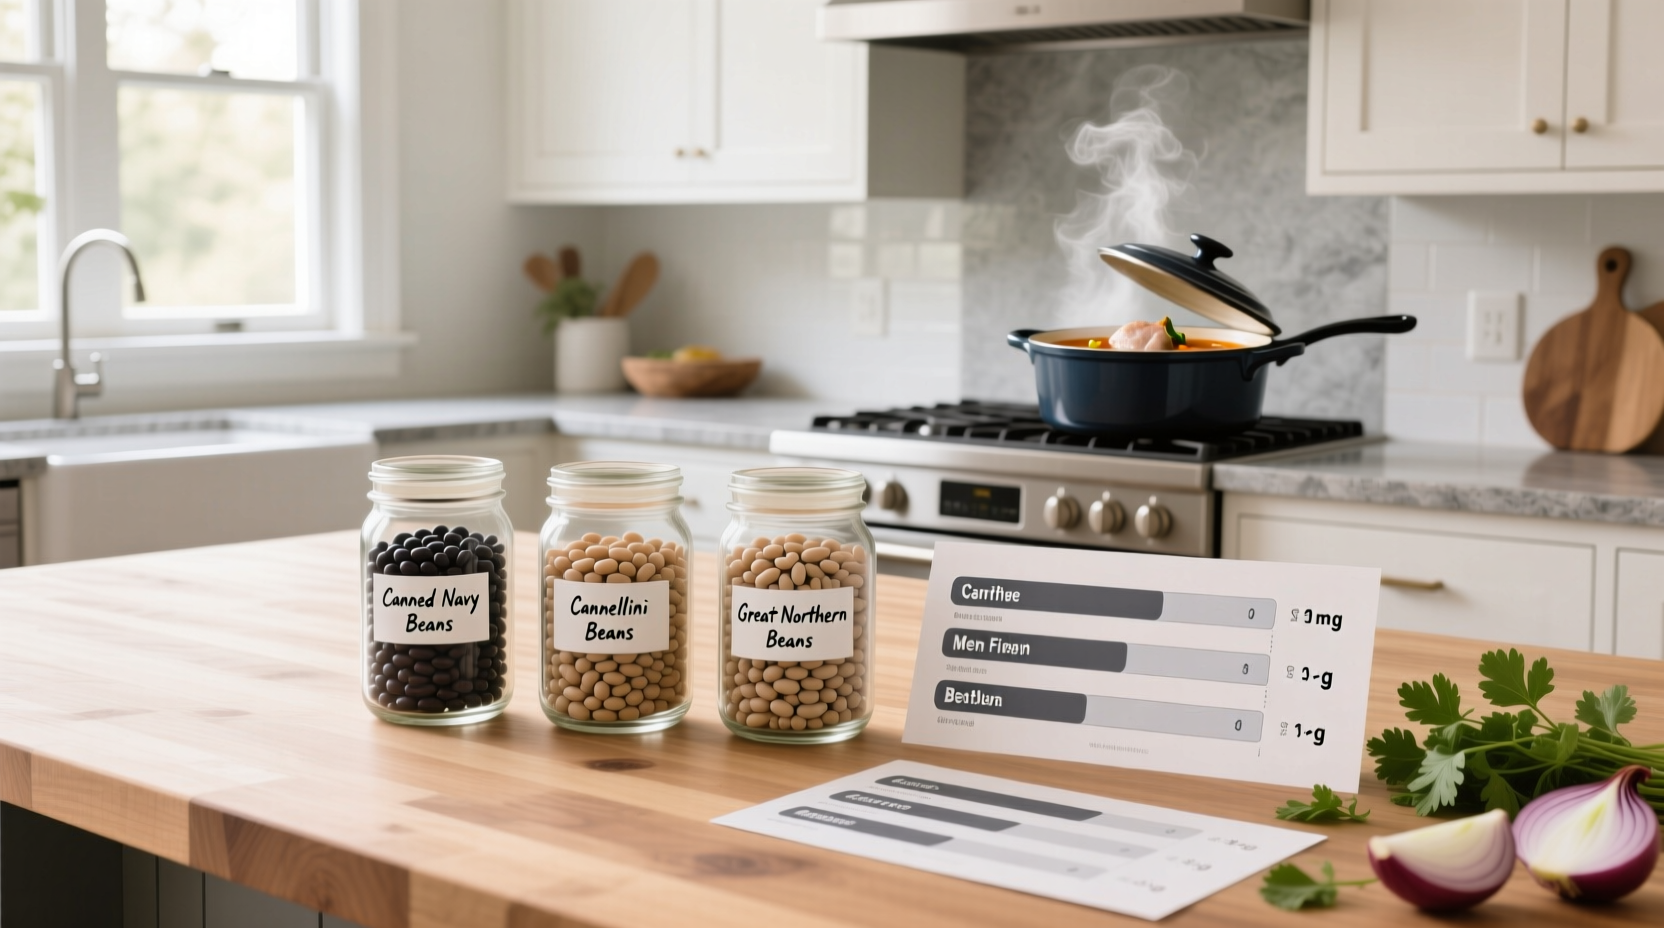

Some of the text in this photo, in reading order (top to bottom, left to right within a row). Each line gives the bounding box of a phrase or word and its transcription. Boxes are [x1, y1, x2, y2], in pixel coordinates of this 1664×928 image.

[382, 587, 480, 615] Canned Navy
[570, 595, 649, 617] Cannellini
[405, 612, 454, 633] Beans
[737, 602, 847, 624] Great Northern
[584, 621, 634, 642] Beans
[765, 629, 813, 649] Beans
